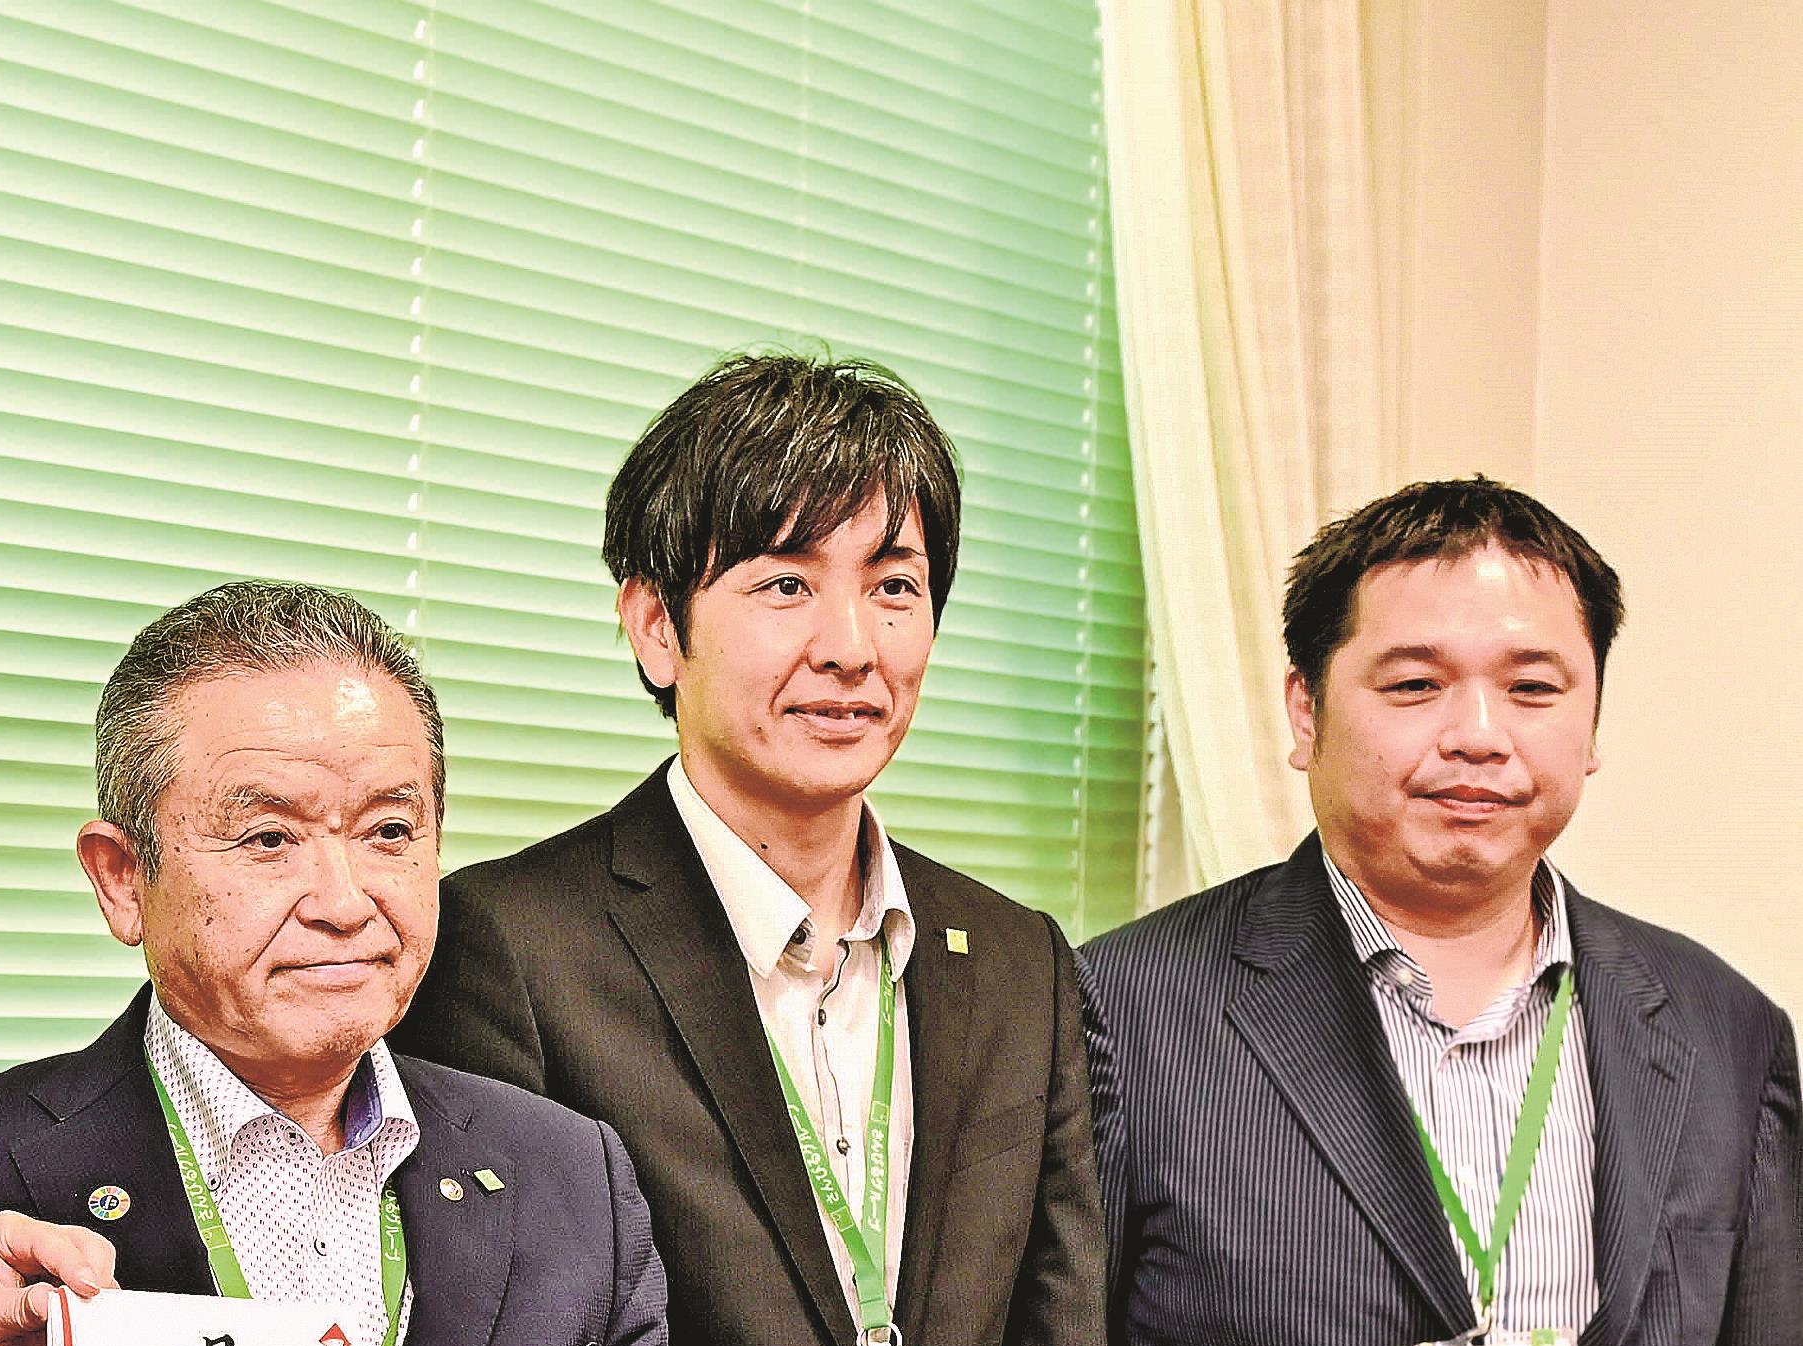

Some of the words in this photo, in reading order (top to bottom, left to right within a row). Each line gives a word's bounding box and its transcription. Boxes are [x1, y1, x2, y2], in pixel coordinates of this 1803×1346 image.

[867, 1128, 885, 1233] さんびるグループ
